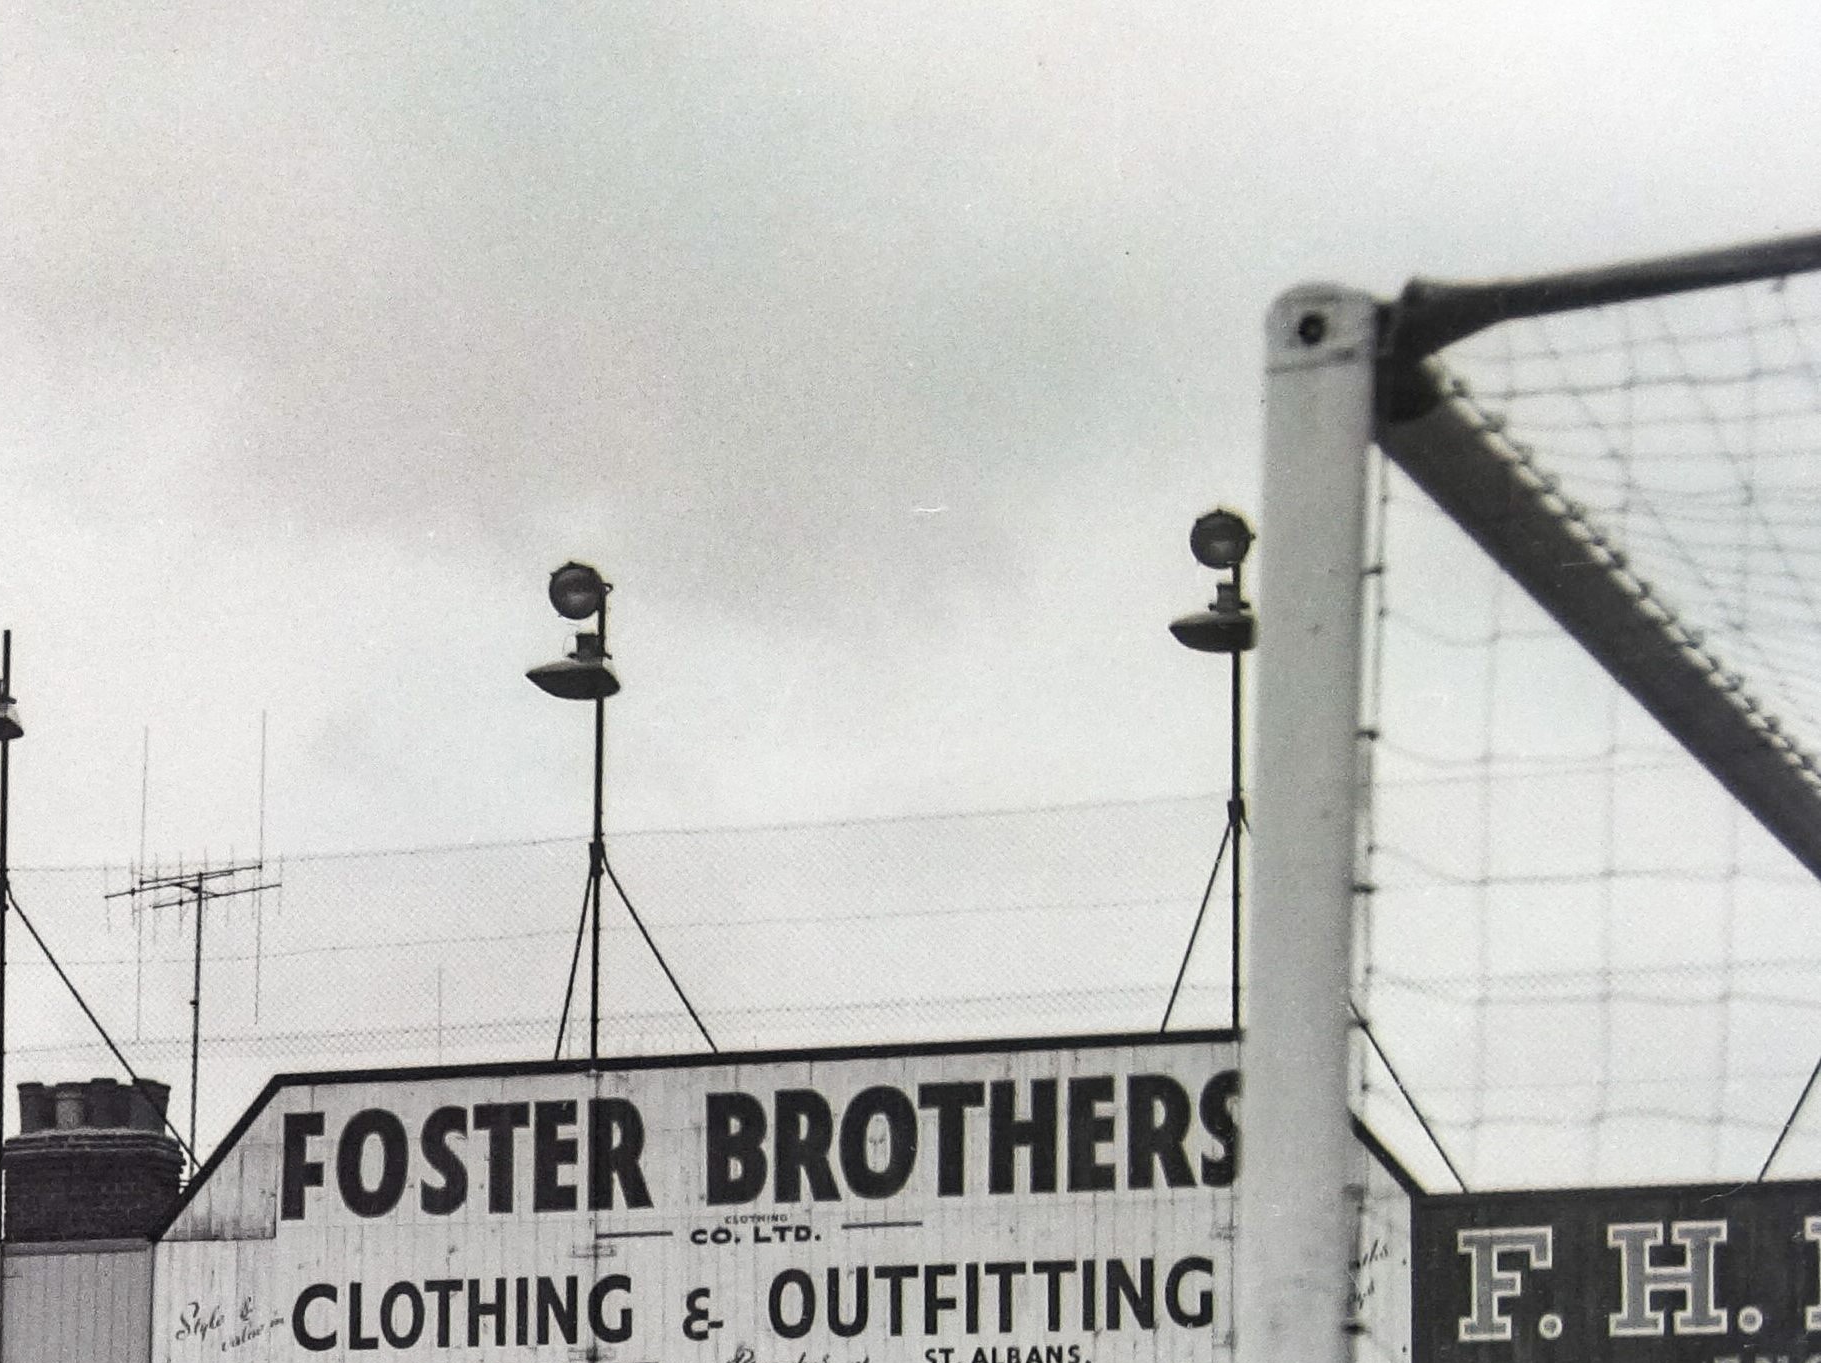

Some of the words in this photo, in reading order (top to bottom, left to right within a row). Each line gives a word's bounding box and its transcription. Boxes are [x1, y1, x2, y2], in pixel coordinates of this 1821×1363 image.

[280, 1098, 654, 1221] FOSTER
[705, 1068, 1241, 1207] BROTHERS
[690, 1228, 741, 1246] CO.
[753, 1225, 821, 1243] LTD.
[724, 1214, 789, 1225] CLOTHING
[292, 1275, 633, 1352] CLOTHING
[682, 1287, 724, 1342] &
[767, 1256, 1215, 1340] OUTFITTING
